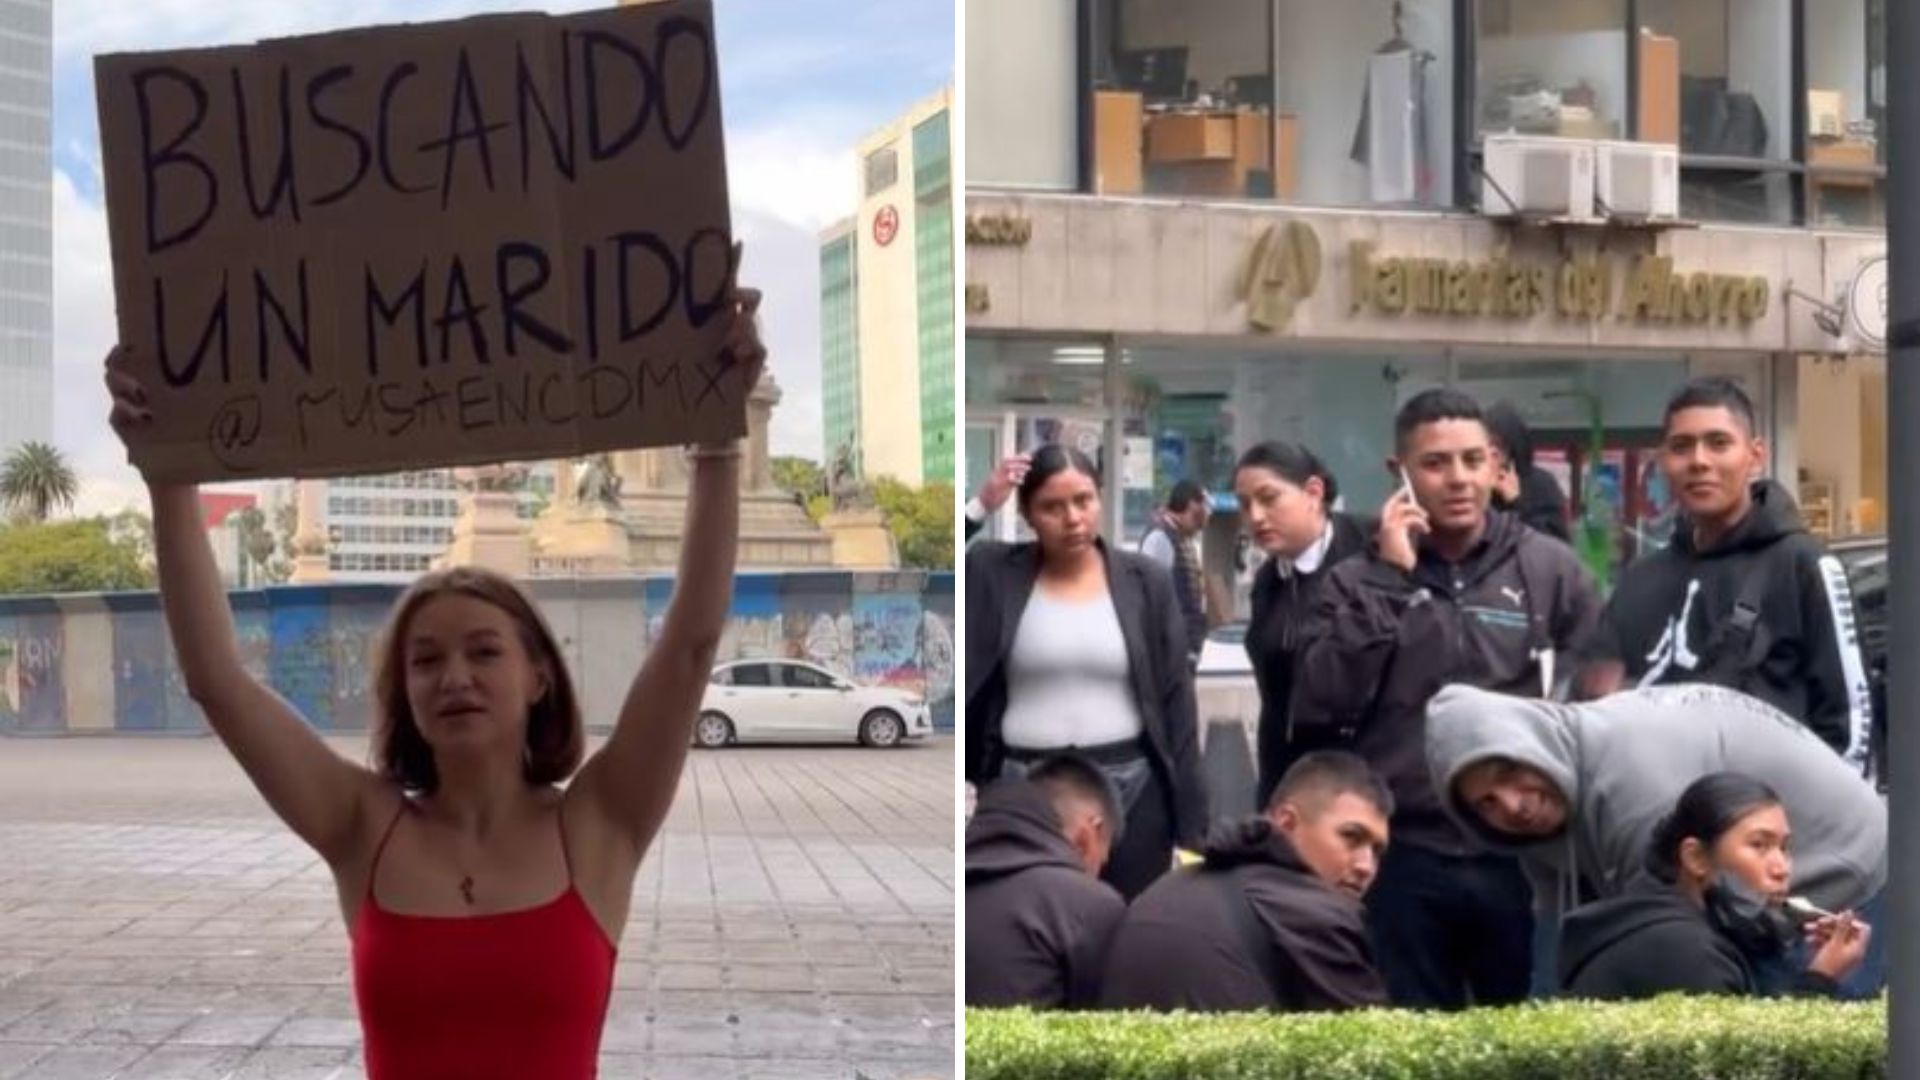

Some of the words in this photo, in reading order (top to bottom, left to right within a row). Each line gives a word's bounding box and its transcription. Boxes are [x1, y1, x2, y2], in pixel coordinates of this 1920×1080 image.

[131, 16, 712, 255] BUSCANDO
[153, 257, 314, 389] UN
[364, 225, 736, 378] MARIDO
[1618, 254, 1769, 324] Ahorro
